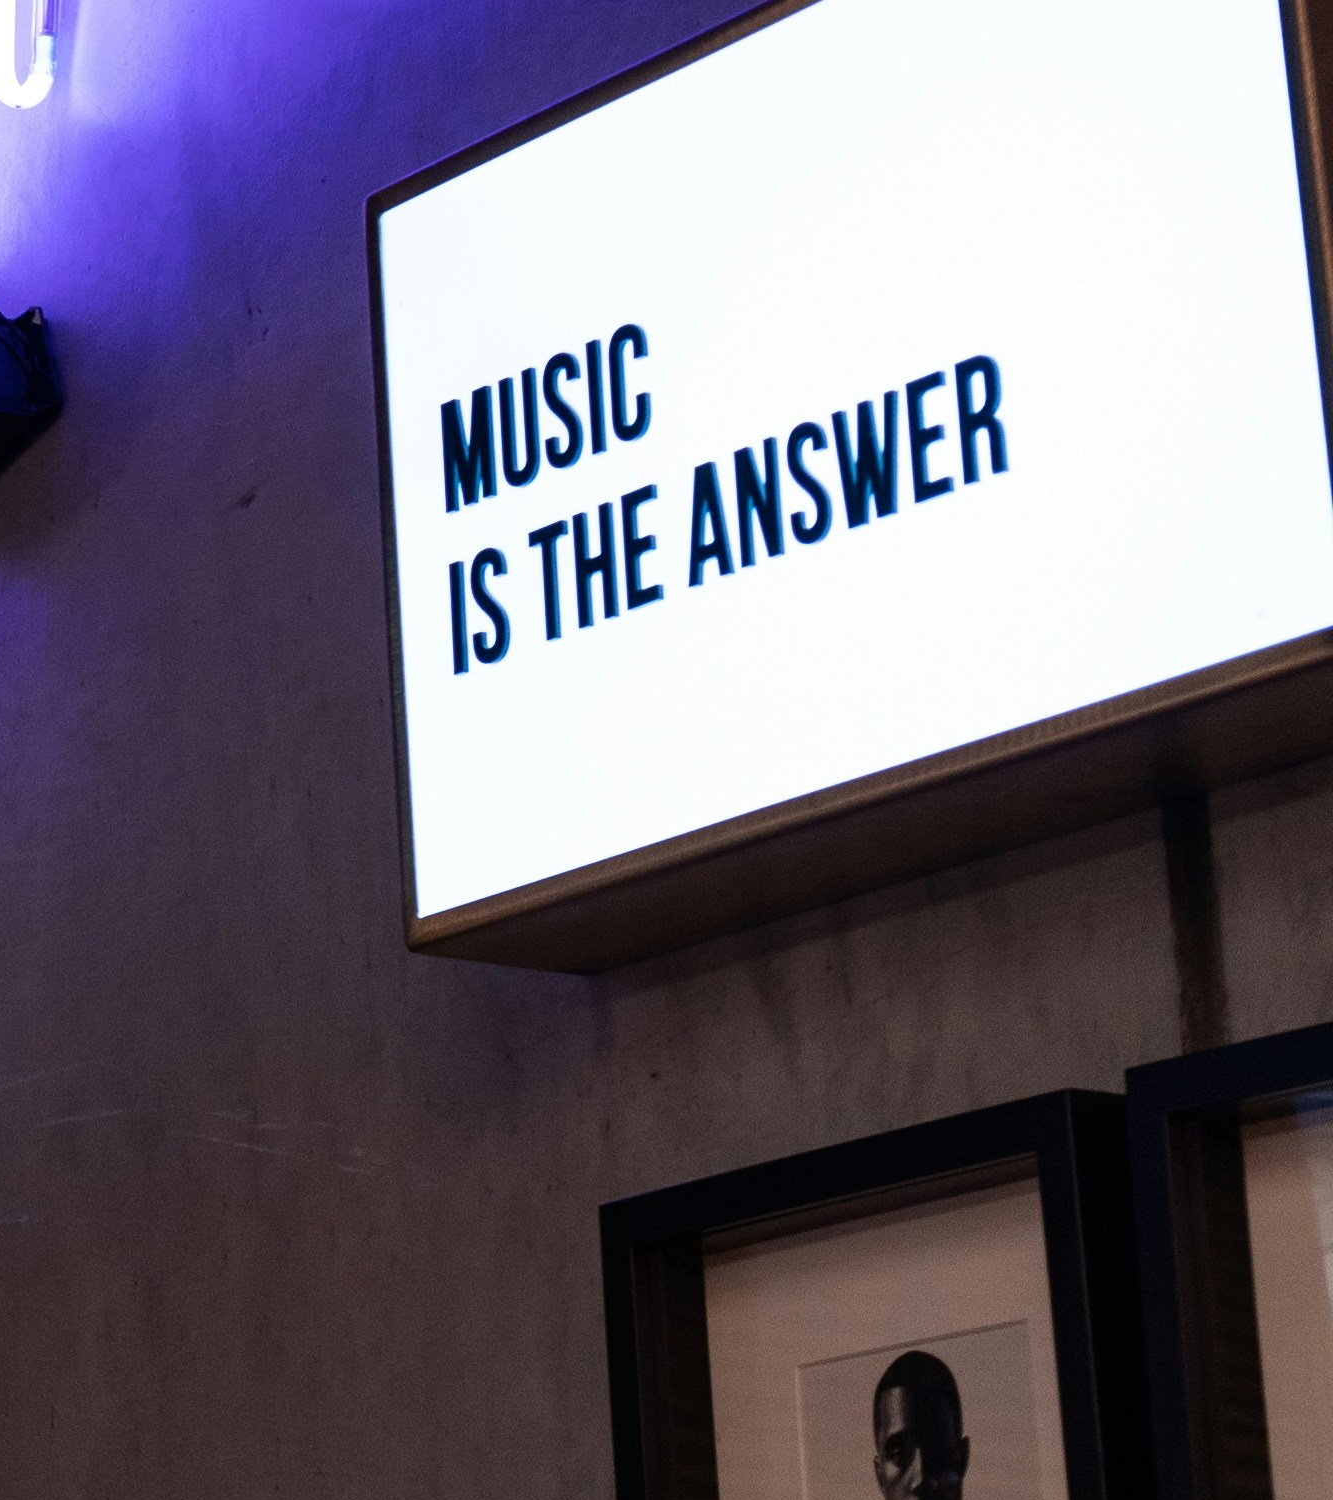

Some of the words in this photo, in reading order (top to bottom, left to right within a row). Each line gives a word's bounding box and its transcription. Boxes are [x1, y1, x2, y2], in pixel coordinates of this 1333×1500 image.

[440, 323, 652, 513] MUSIC
[448, 547, 511, 675] IS
[528, 484, 664, 641] THE
[688, 355, 1009, 588] ANSWER
